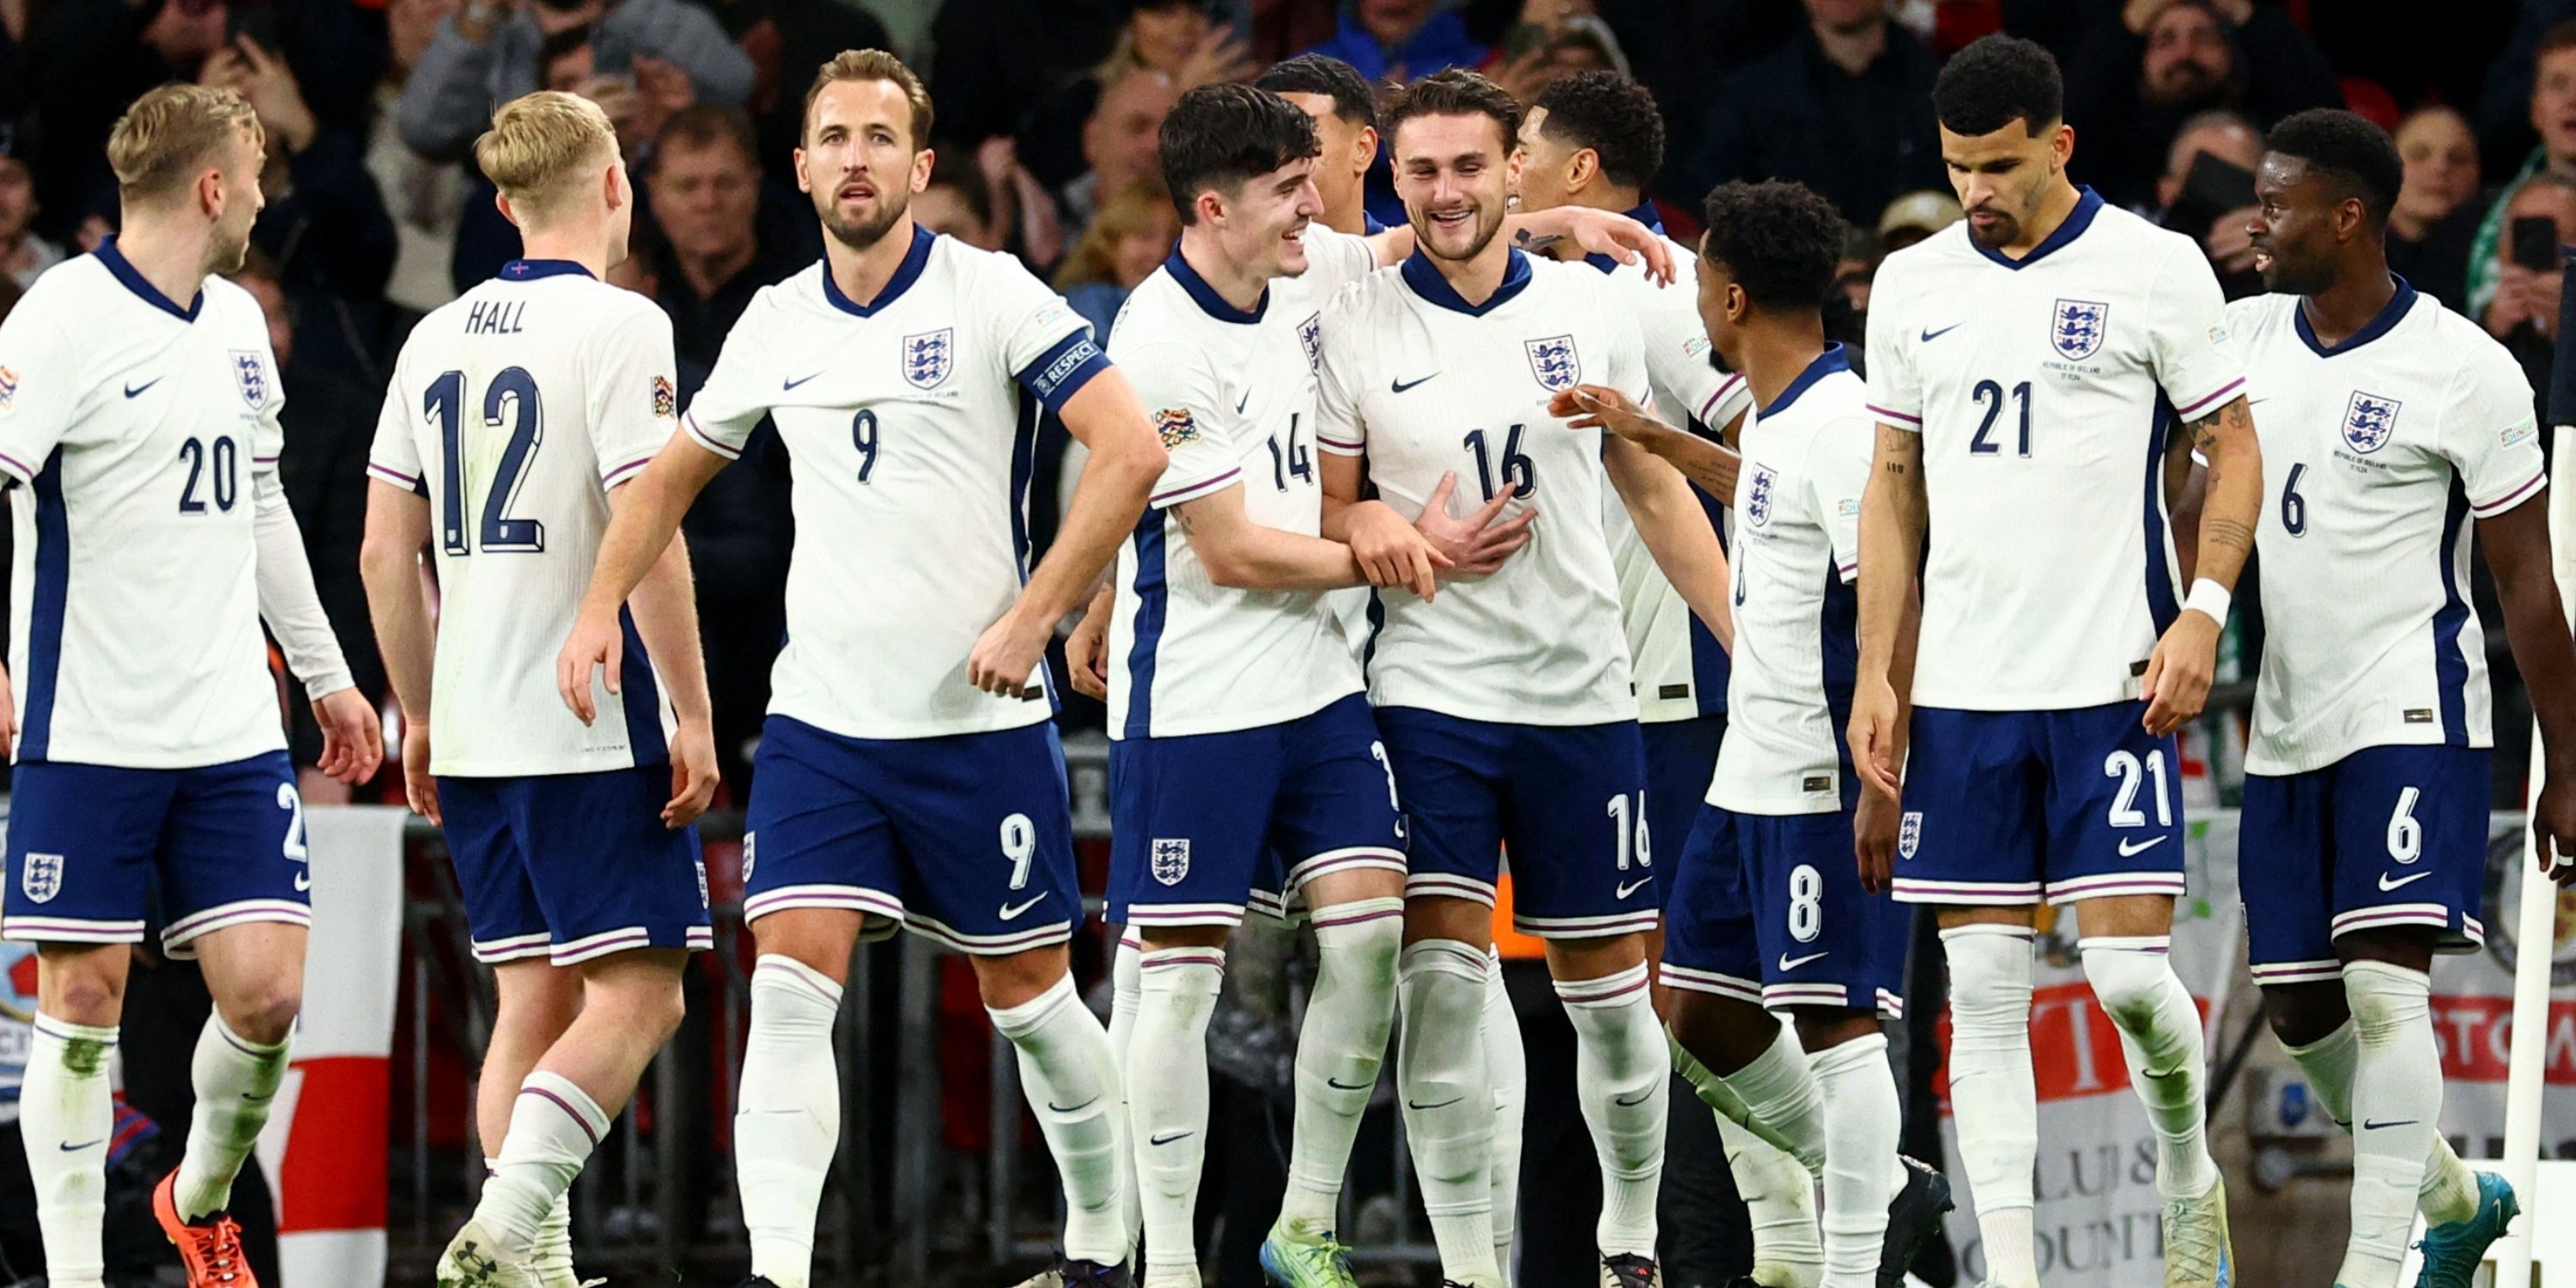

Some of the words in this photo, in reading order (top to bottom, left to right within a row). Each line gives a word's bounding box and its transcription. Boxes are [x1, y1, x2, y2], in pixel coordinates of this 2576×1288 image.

[465, 301, 526, 334] HALL
[1047, 343, 1095, 383] RESPECT
[853, 409, 881, 485] 9
[1267, 412, 1314, 493] 14
[1970, 379, 2033, 459] 21
[179, 435, 237, 515] 20
[424, 365, 544, 556] 12
[1463, 423, 1538, 504] 16
[2281, 463, 2308, 538] 6
[277, 781, 308, 863] 2
[2105, 750, 2172, 828] 21
[2387, 787, 2421, 864] 6
[1000, 812, 1036, 890] 9
[1607, 789, 1651, 871] 16
[1789, 864, 1822, 943] 8
